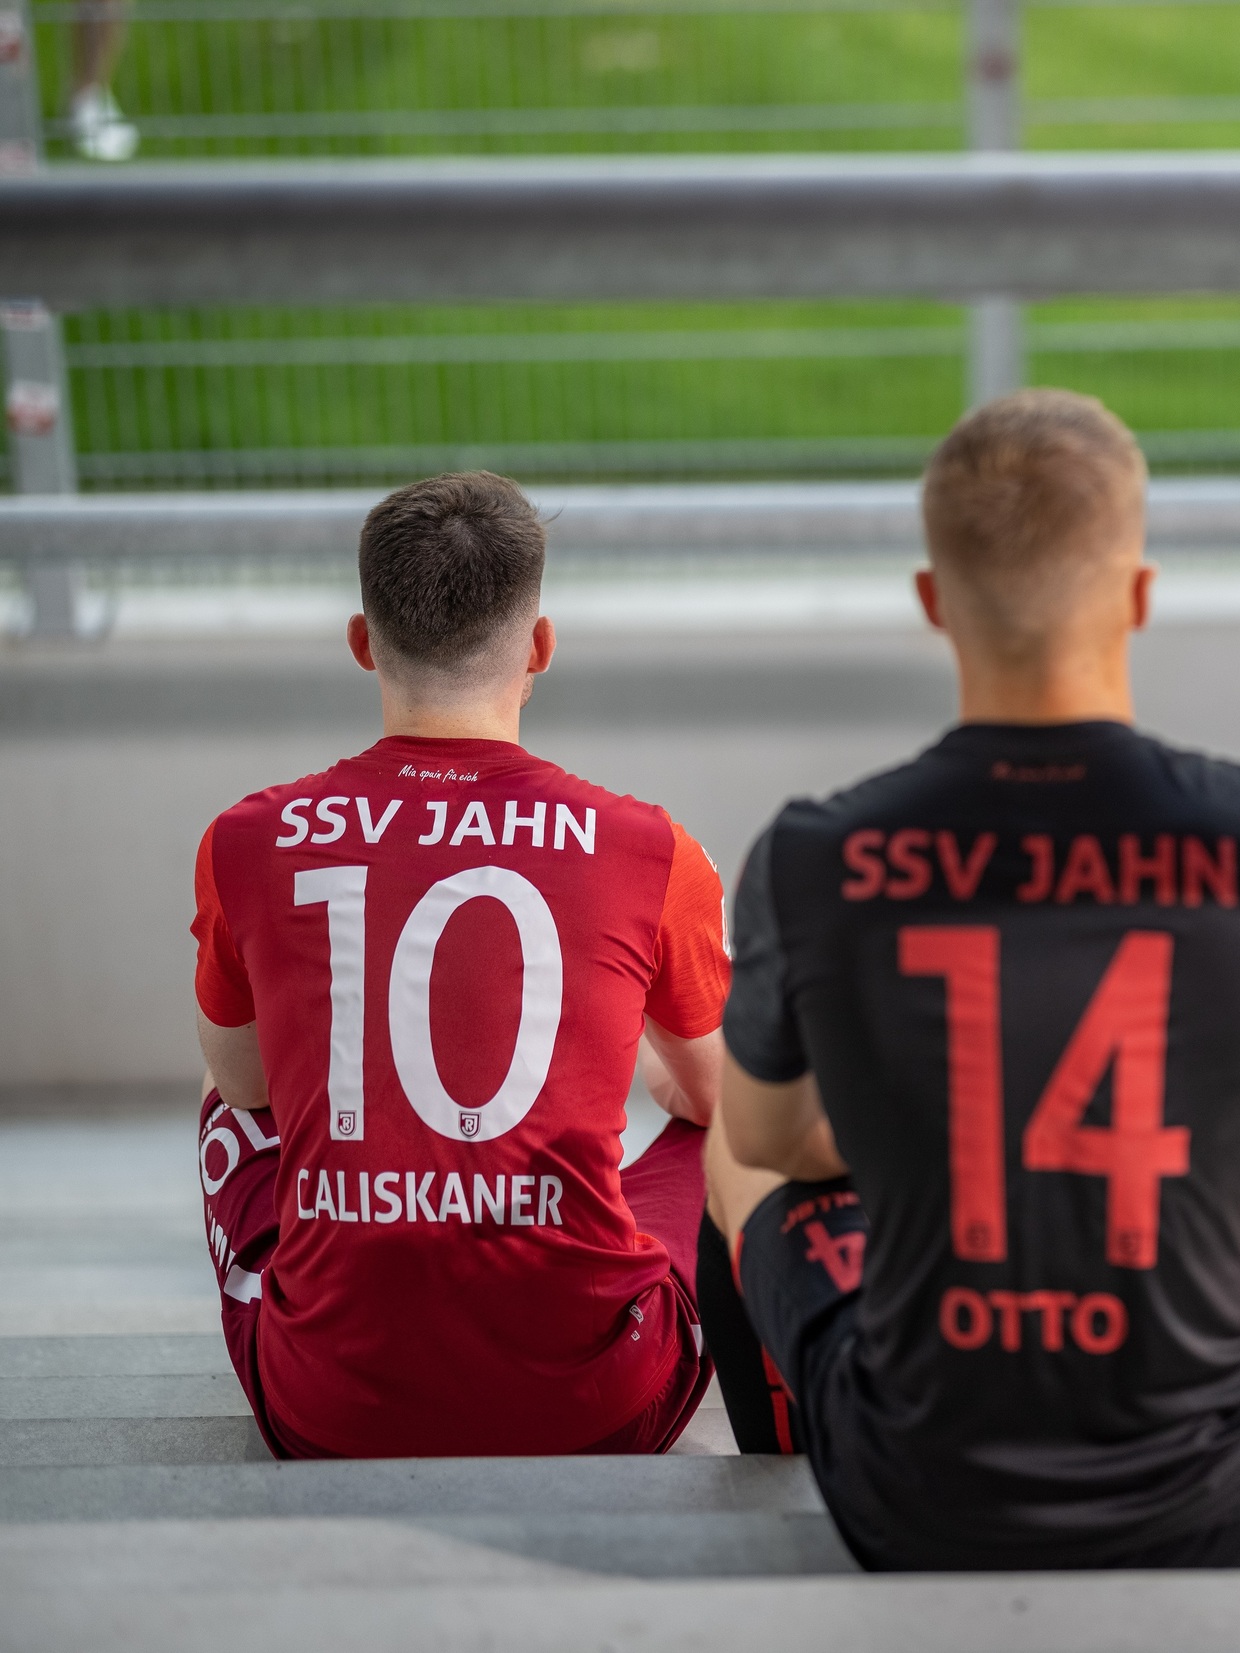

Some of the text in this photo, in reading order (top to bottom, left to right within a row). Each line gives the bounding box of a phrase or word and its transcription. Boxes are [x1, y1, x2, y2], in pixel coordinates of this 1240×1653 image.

[398, 764, 417, 778] Mia
[458, 771, 479, 782] eich
[276, 795, 597, 855] SSV JAHN
[845, 830, 1238, 907] SSV JAHN
[293, 865, 564, 1143] 10
[898, 926, 1191, 1269] 14
[297, 1167, 563, 1227] CALISKANER
[940, 1288, 1127, 1355] OTTO
